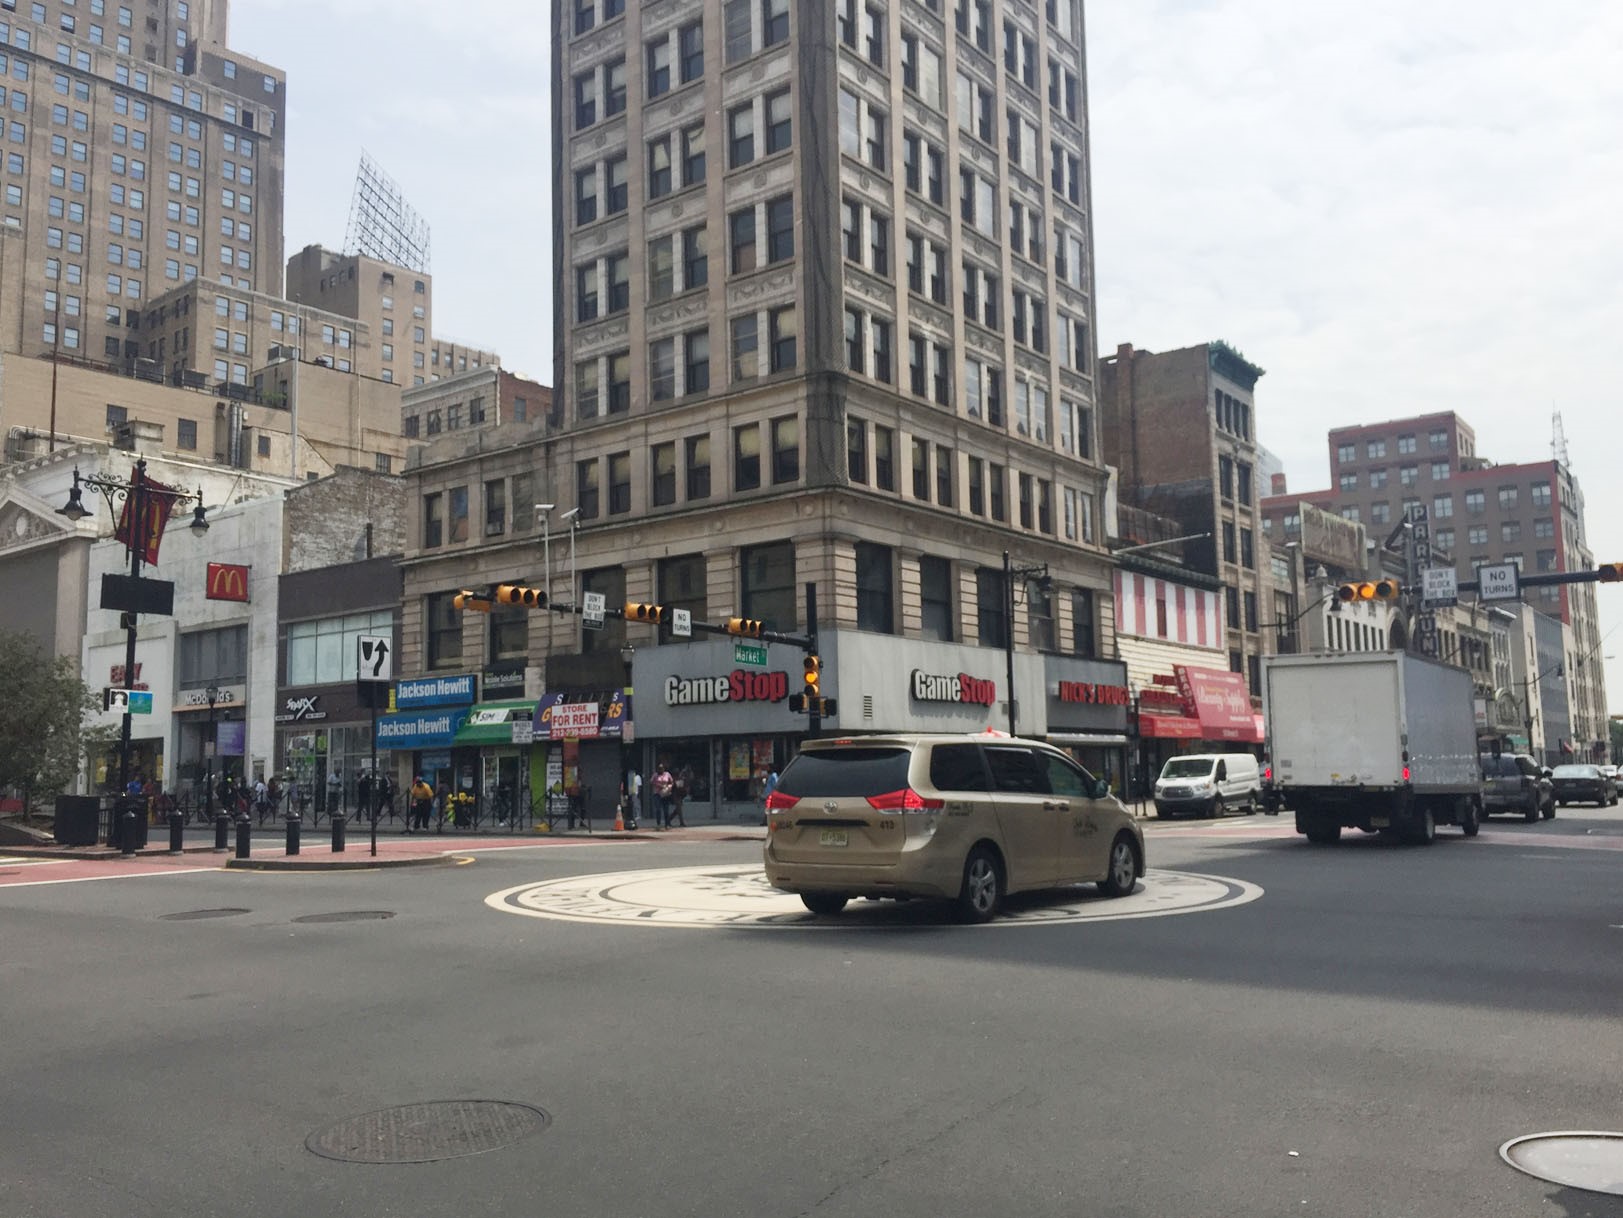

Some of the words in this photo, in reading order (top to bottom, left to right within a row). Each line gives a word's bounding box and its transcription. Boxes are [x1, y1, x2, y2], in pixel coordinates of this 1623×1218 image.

[1489, 571, 1506, 581] NO
[1484, 583, 1514, 594] TURNS
[677, 613, 687, 621] NO
[674, 623, 691, 632] TURNS
[736, 647, 760, 664] Market
[398, 682, 437, 699] Jackson
[437, 677, 470, 695] Hewitt
[664, 669, 787, 705] GameStop
[914, 670, 996, 707] GameStop
[1060, 680, 1095, 704] NICK'S
[1098, 684, 1131, 706] DRUGS
[185, 691, 233, 705] McDold's
[562, 704, 588, 714] STORE
[377, 721, 417, 737] Jackson
[417, 716, 450, 735] Hewitt
[553, 714, 571, 727] FOR
[573, 712, 598, 726] RENT
